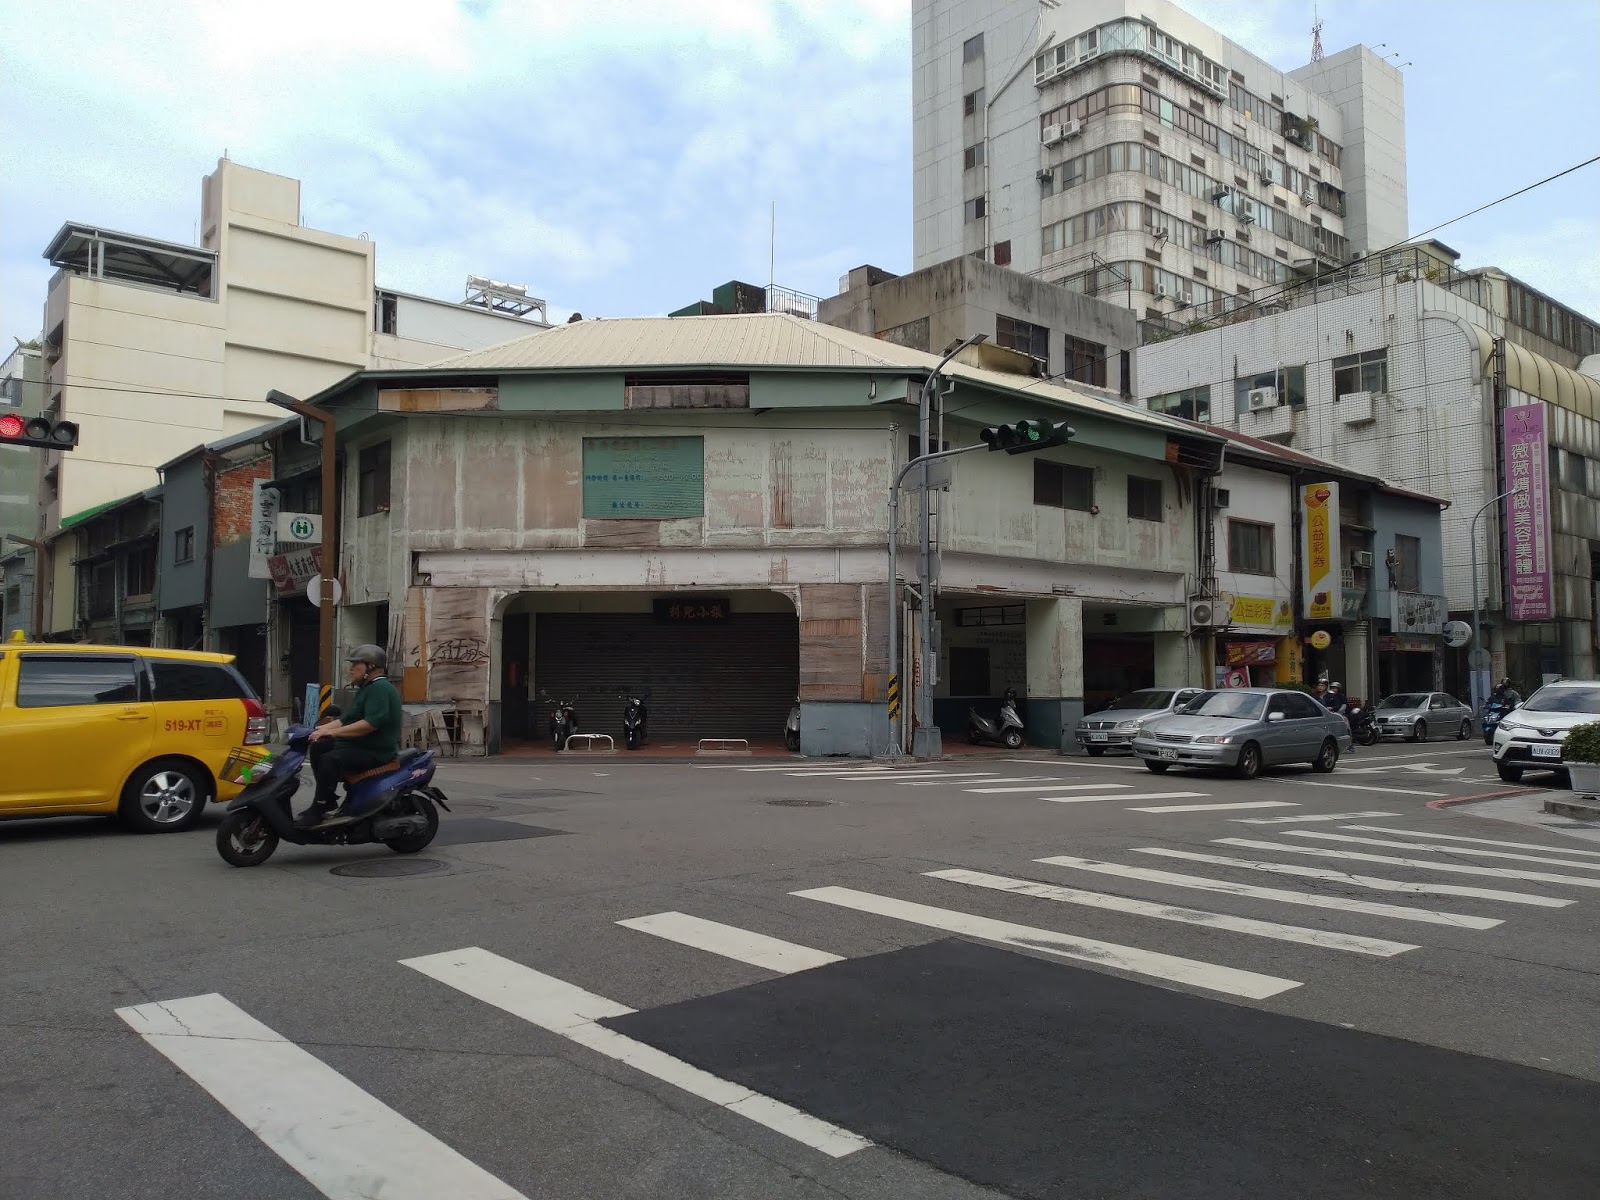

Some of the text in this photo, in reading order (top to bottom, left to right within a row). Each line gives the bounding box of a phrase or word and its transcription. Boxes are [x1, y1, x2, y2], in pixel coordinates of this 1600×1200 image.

[1312, 514, 1326, 569] 公益彩券
[1235, 601, 1273, 620] 公益彩券
[165, 719, 202, 731] 519-XT
